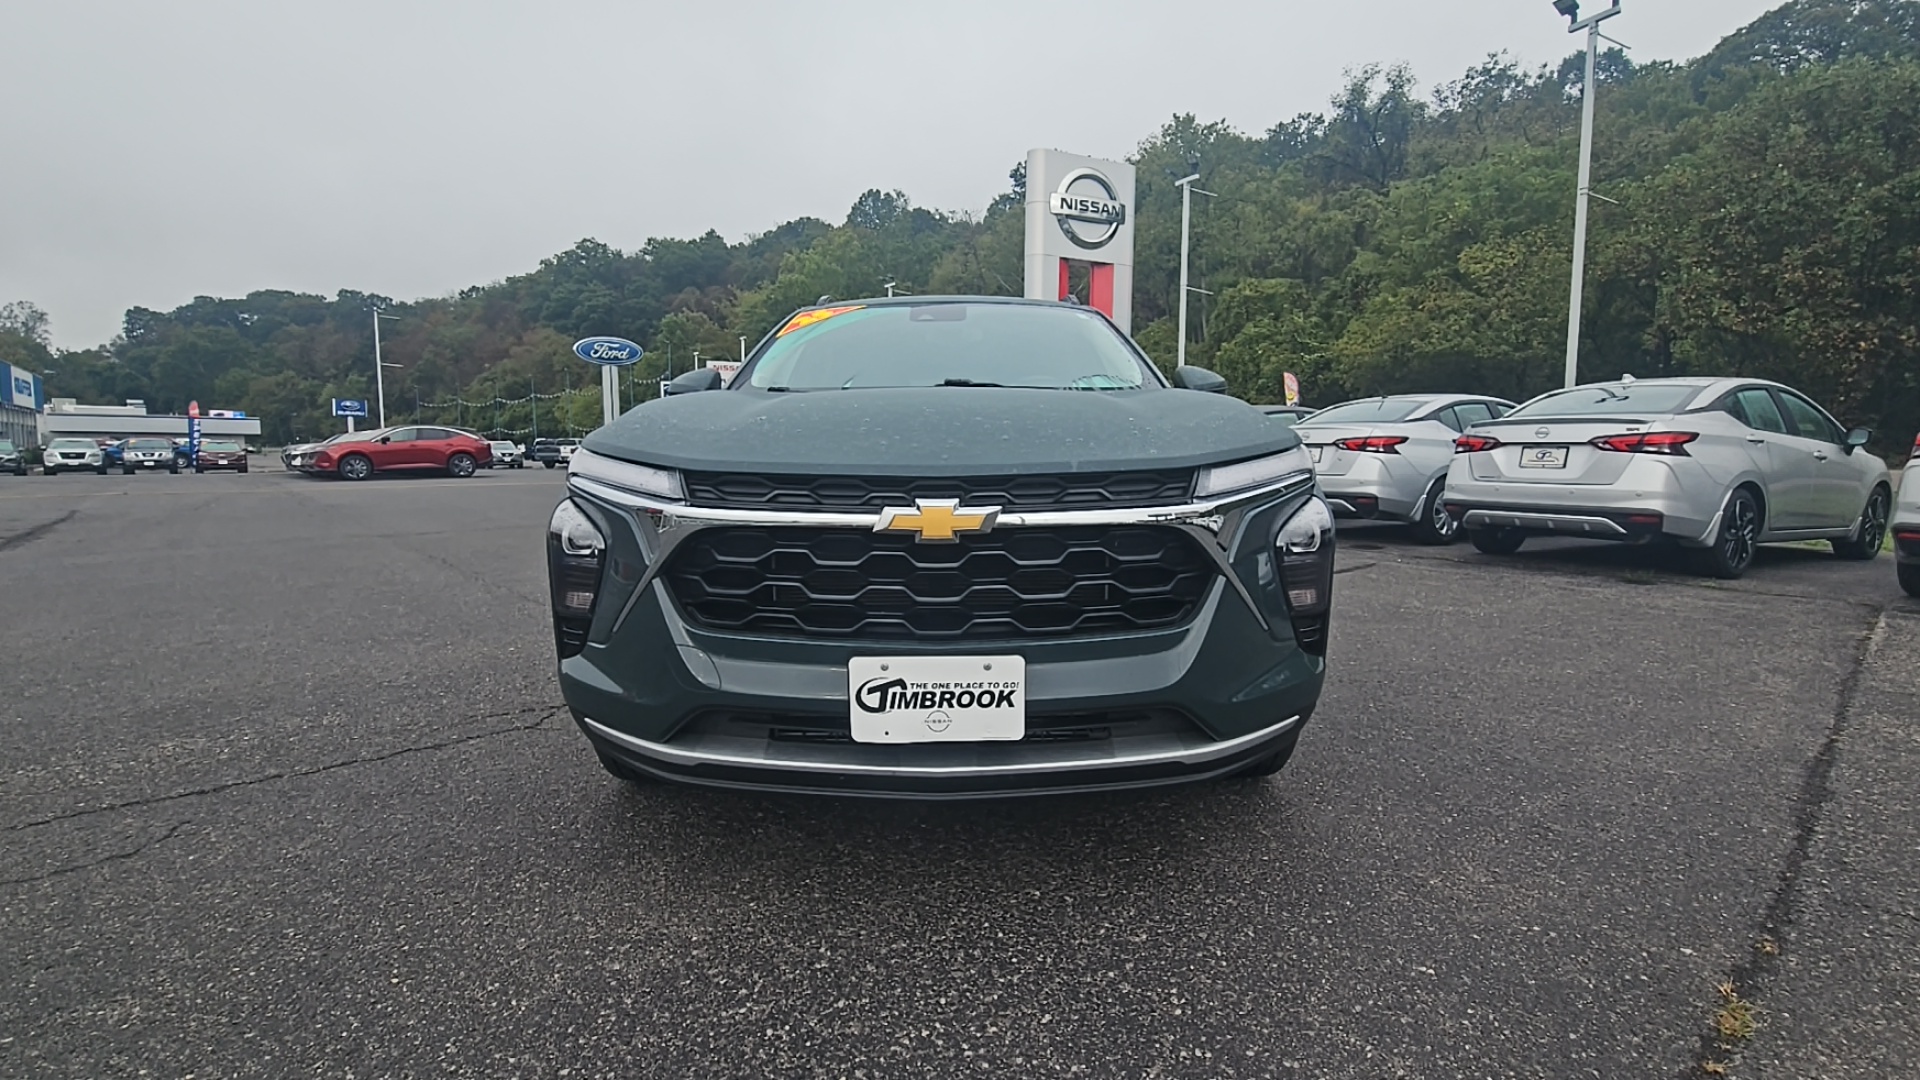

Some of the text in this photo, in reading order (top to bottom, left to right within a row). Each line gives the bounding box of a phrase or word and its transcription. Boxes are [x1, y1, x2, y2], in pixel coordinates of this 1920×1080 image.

[1060, 197, 1121, 217] NISSAN
[590, 342, 630, 359] Ford
[1002, 681, 1019, 689] GO!
[856, 677, 1017, 713] TIMBROOK
